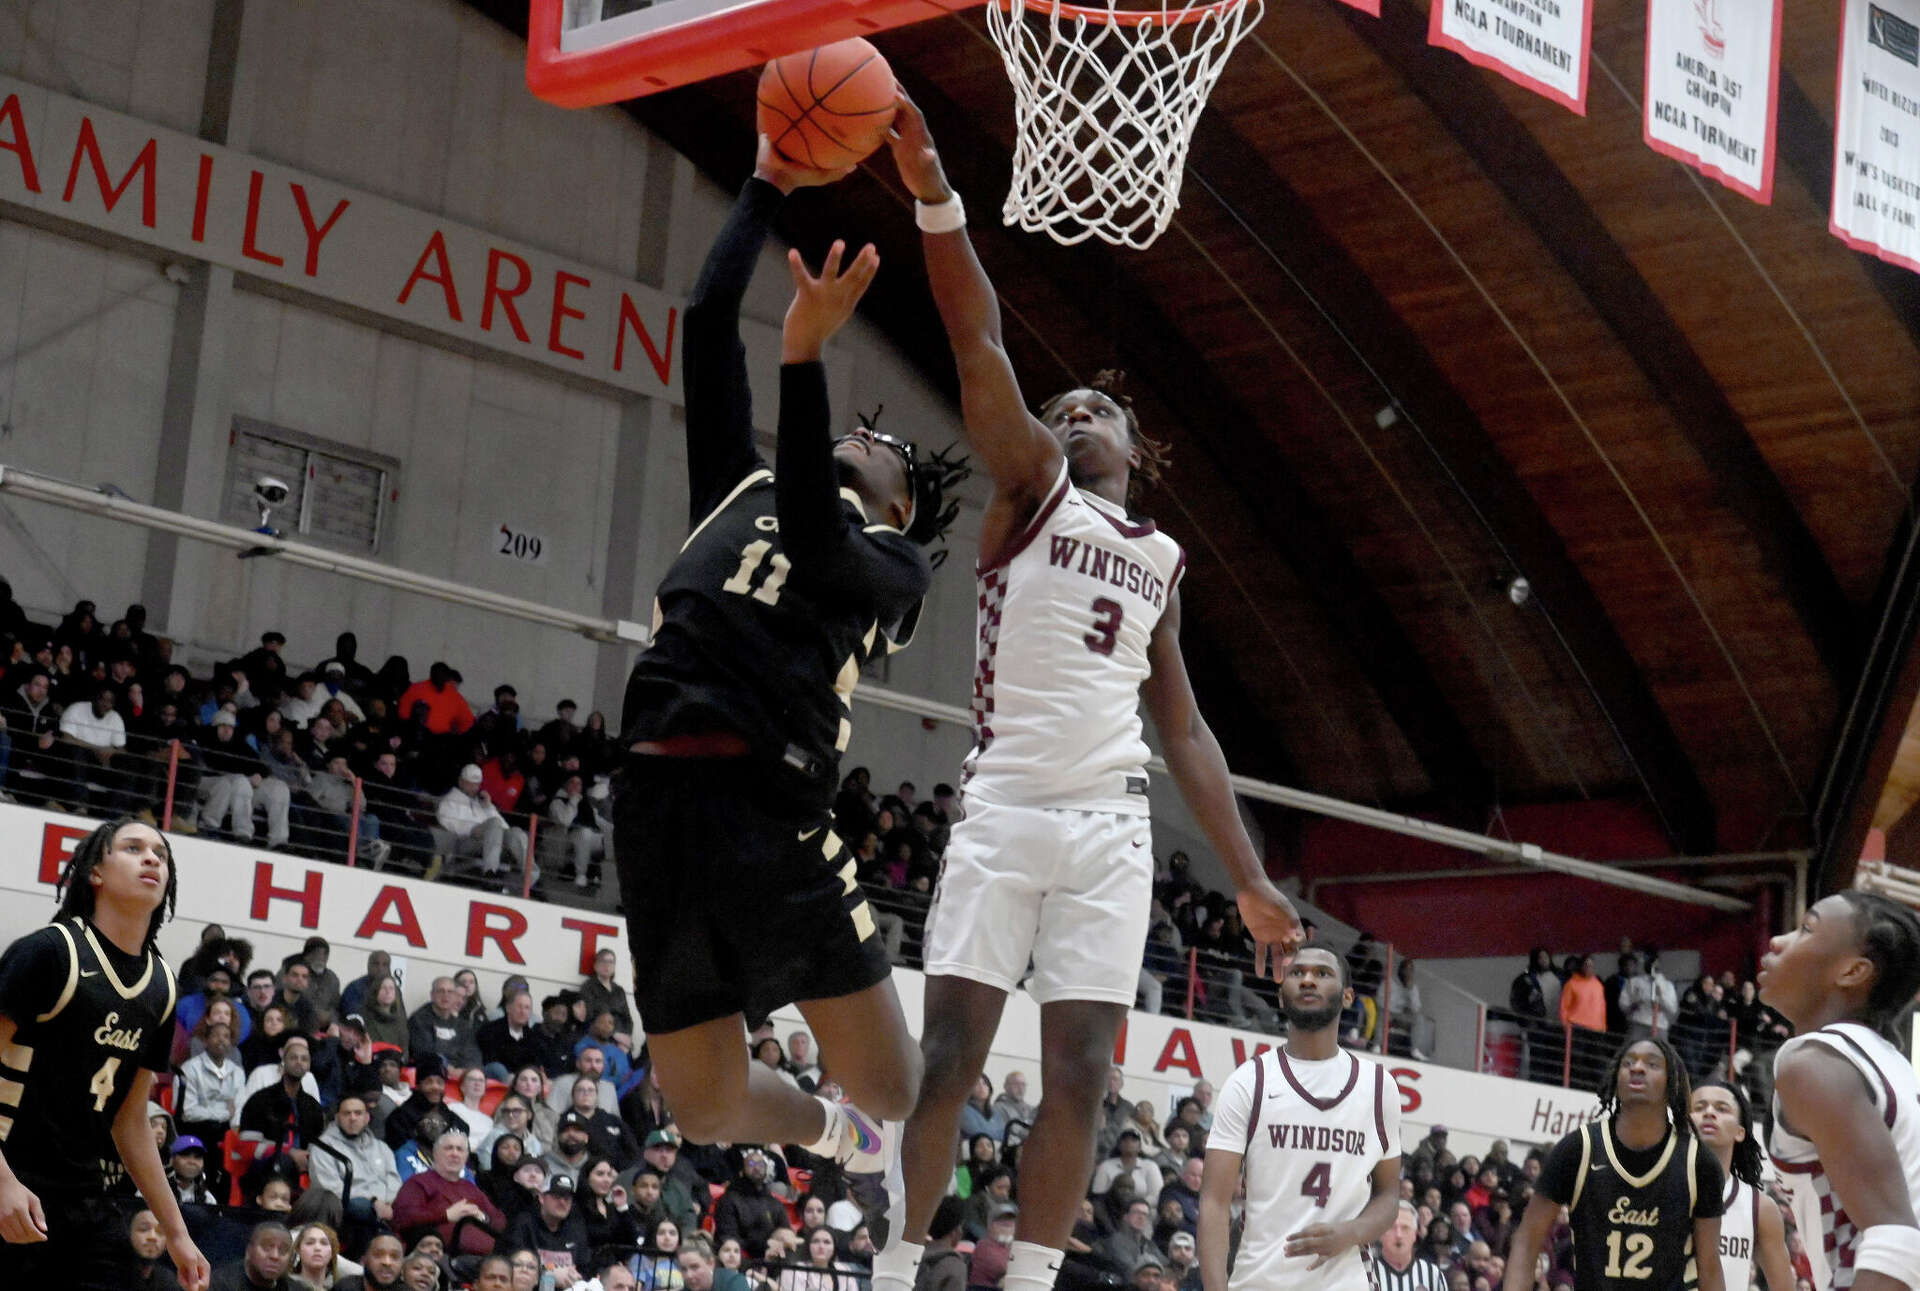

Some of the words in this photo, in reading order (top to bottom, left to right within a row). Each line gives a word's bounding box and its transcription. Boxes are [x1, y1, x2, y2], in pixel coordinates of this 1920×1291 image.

[1495, 16, 1572, 73] TOURNAMENT
[1655, 100, 1688, 131] NCAA
[0, 94, 350, 277] AMILY
[396, 229, 677, 386] AREN
[499, 526, 543, 561] 209
[723, 539, 792, 606] 11
[1049, 534, 1164, 612] WINDSOR
[1083, 597, 1123, 657] 3
[94, 1010, 143, 1051] East
[89, 1056, 122, 1112] 4
[1268, 1124, 1366, 1156] WINDSOR
[1301, 1162, 1332, 1208] 4
[1608, 1195, 1660, 1226] East
[1604, 1230, 1654, 1280] 12
